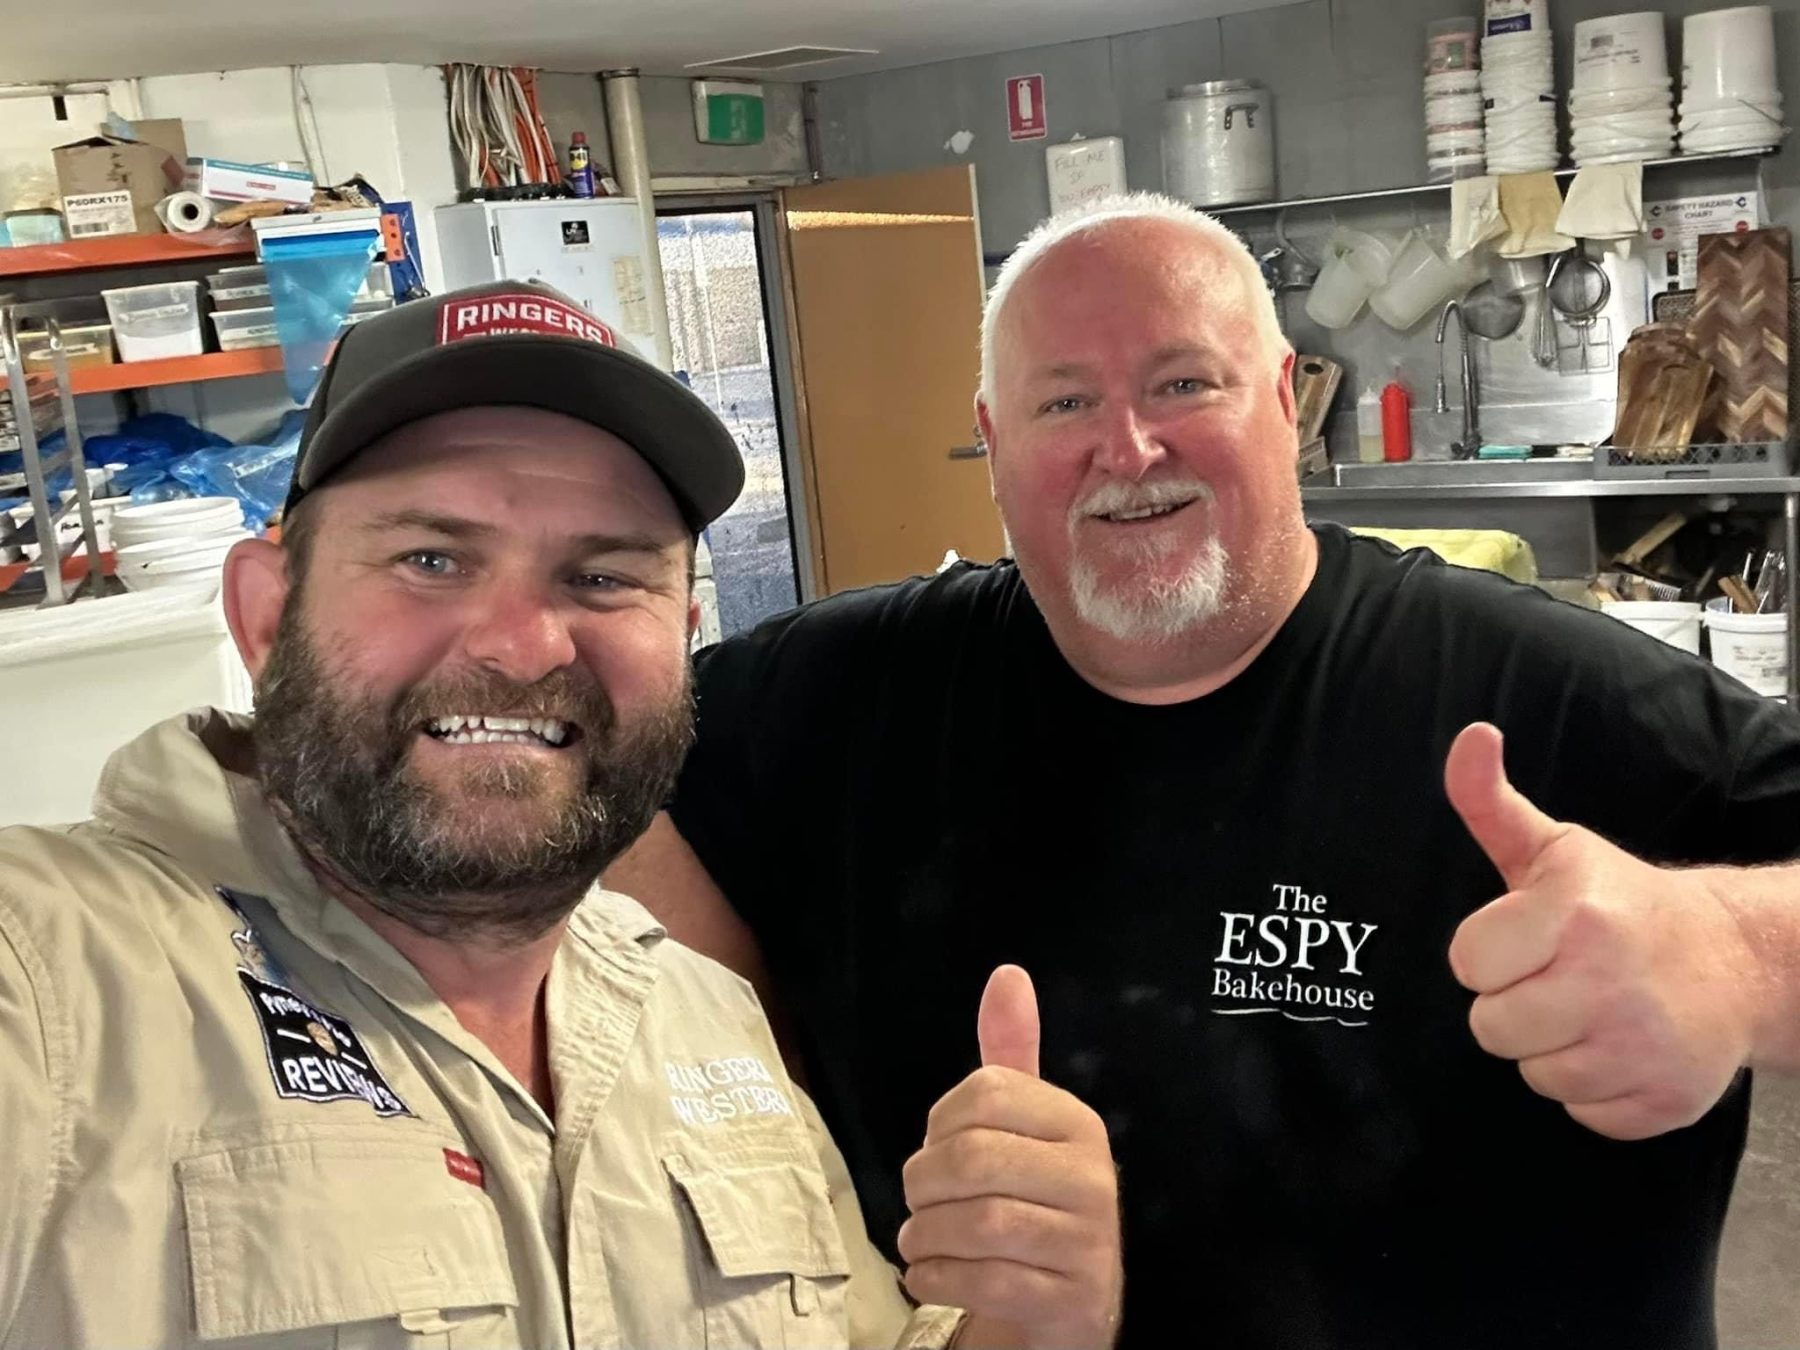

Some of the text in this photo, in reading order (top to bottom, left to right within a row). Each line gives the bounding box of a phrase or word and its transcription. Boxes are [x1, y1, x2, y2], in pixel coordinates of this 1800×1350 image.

[457, 301, 602, 344] RINGERS
[1273, 883, 1327, 913] The
[1214, 911, 1378, 976] ESPY
[1211, 968, 1374, 1011] Bakehouse
